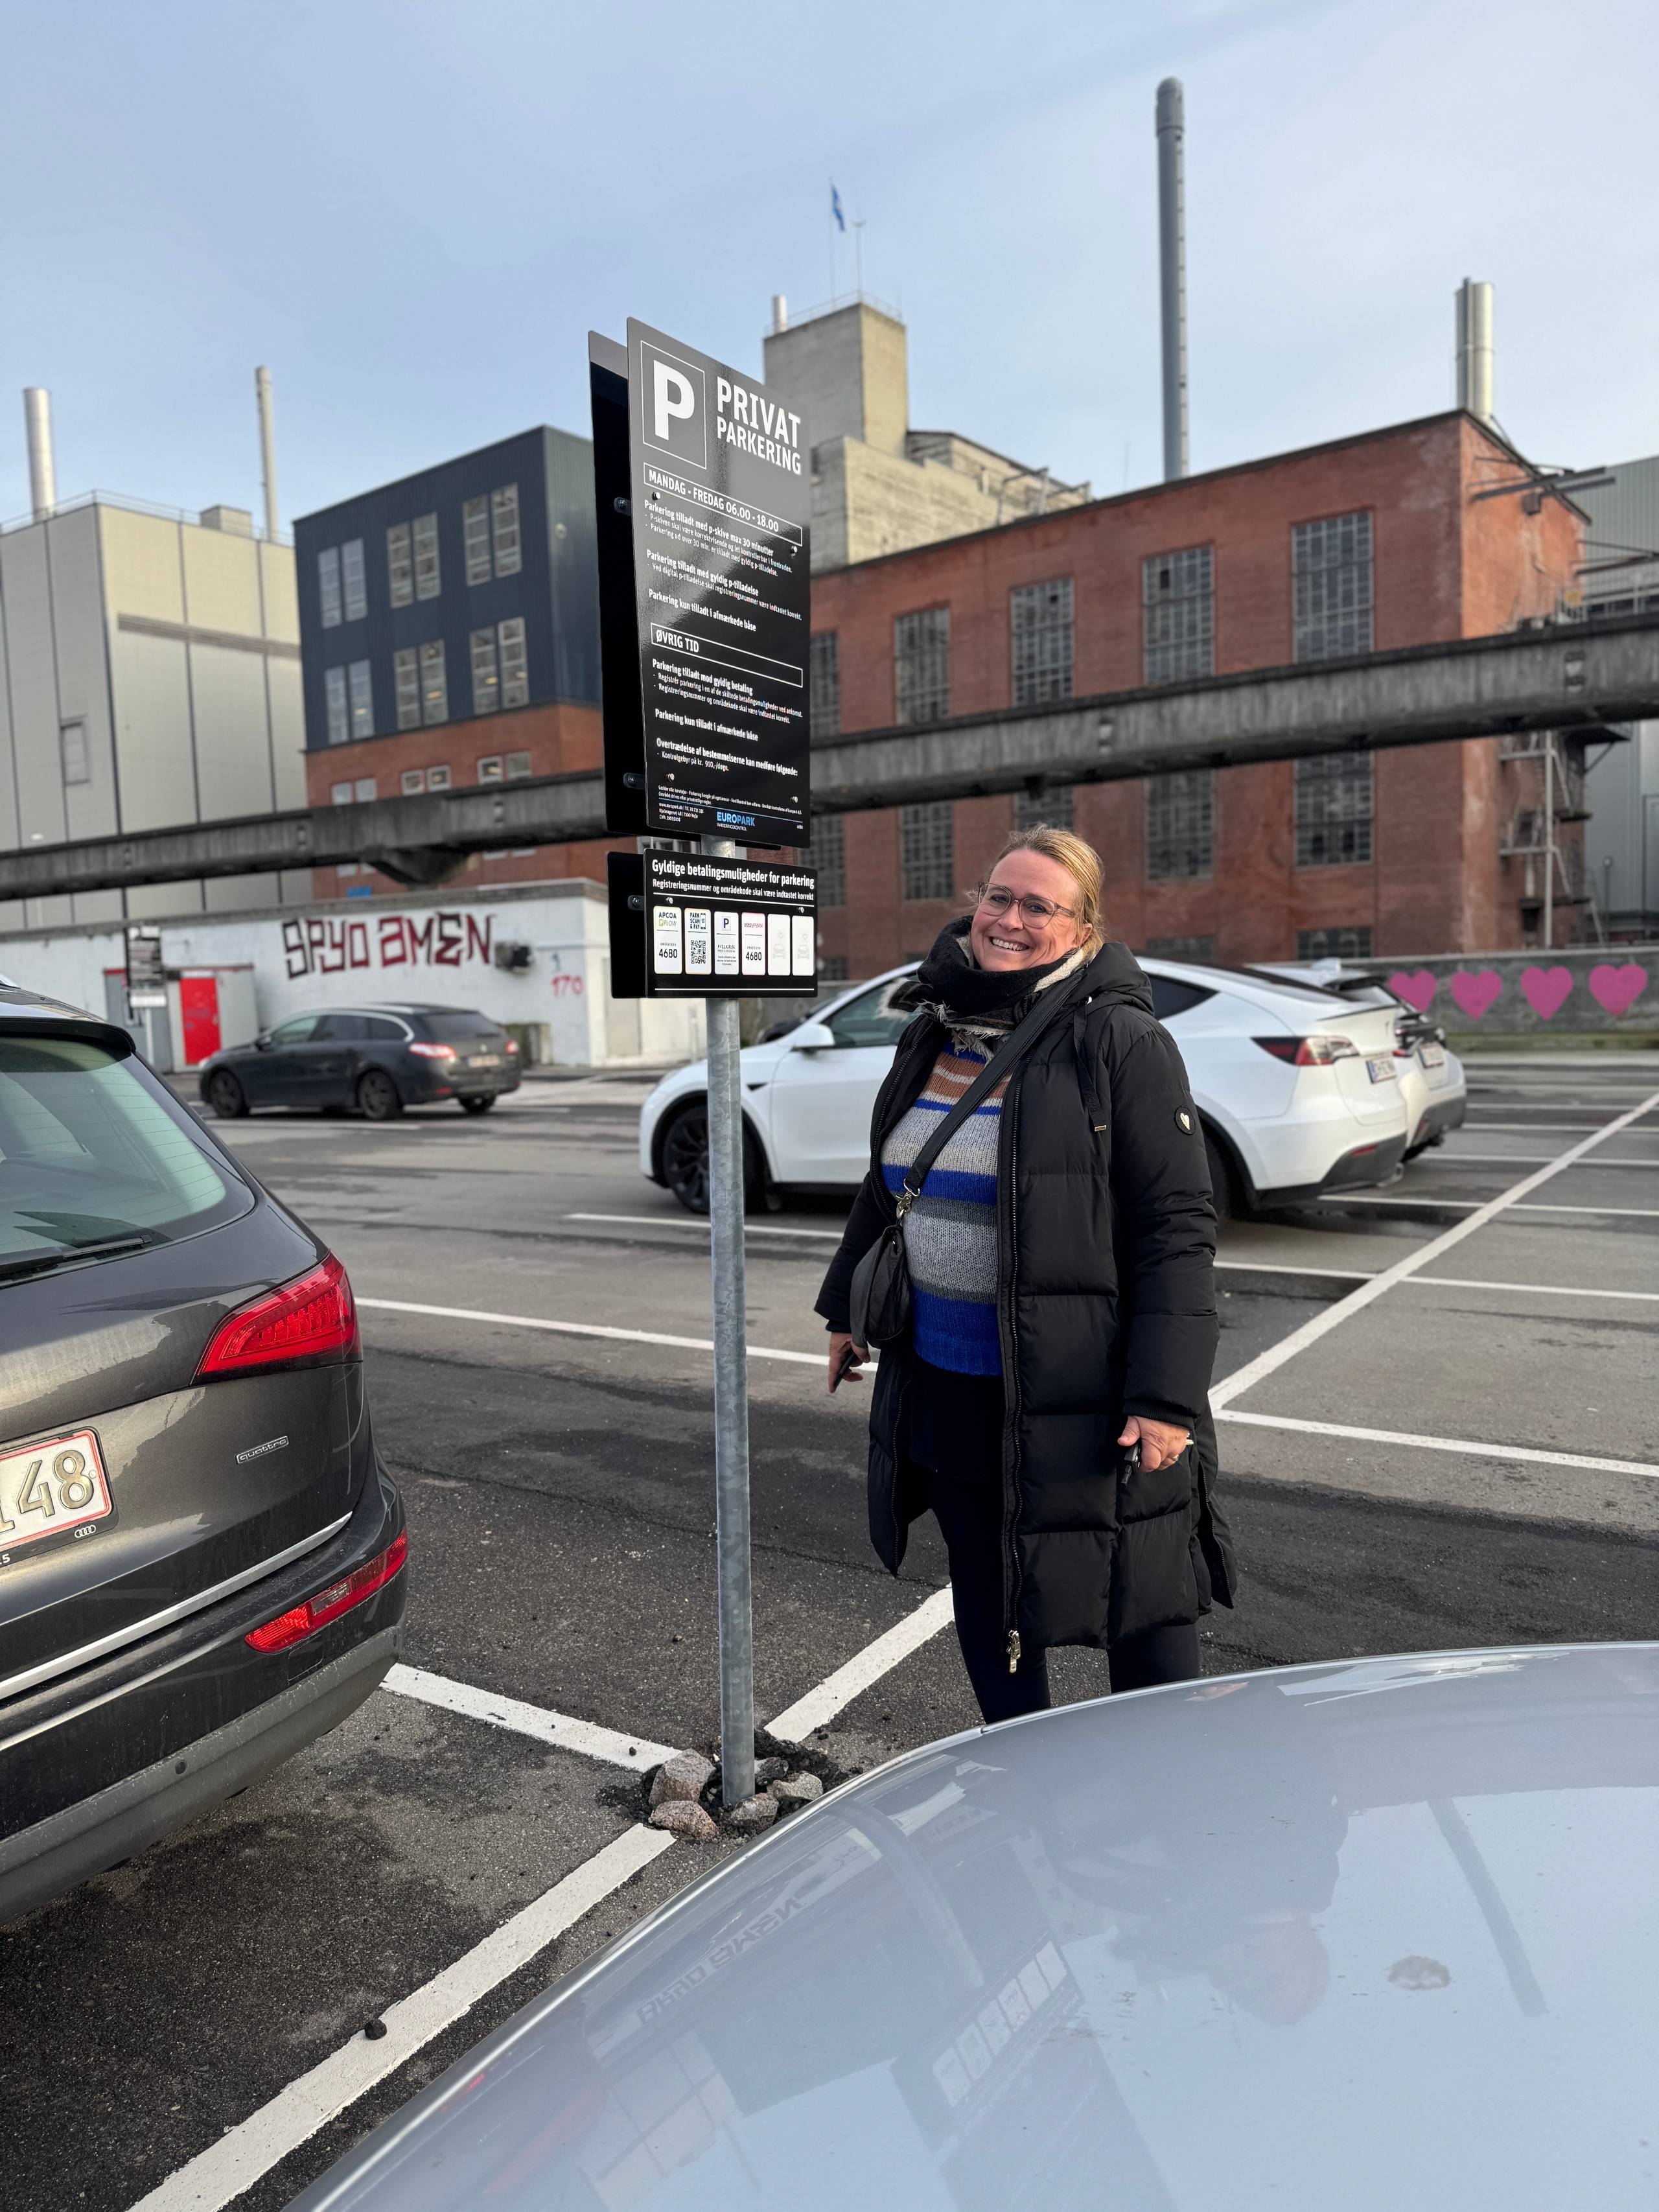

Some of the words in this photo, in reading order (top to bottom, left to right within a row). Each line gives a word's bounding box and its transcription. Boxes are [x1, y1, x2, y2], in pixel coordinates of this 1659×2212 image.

[654, 360, 695, 441] P
[717, 376, 801, 448] PRIVAT
[717, 415, 802, 476] PARKERING
[649, 469, 685, 495] MANDAG
[693, 487, 724, 511] FREDAG
[726, 500, 750, 521] 06.00
[757, 513, 778, 533] 18.00
[644, 498, 674, 521] Parkering
[675, 510, 693, 526] tilladt
[695, 518, 707, 531] med
[708, 523, 728, 541] p-skive
[730, 534, 741, 544] max
[742, 537, 750, 548] 30
[751, 540, 773, 557] minutter
[651, 522, 673, 539] Parkering
[675, 531, 680, 541] ud
[682, 535, 691, 544] over
[693, 538, 699, 548] 30
[717, 547, 730, 559] tilladt
[730, 552, 739, 563] med
[671, 520, 680, 531] skal
[682, 526, 693, 535] være
[647, 548, 676, 570] Parkering
[677, 559, 695, 575] tilladt
[697, 566, 708, 579] med
[710, 570, 727, 587] gyldig
[728, 577, 758, 598] p-tilladelse
[652, 562, 661, 572] Ved
[662, 565, 677, 579] digital
[679, 570, 704, 588] p-tilladelse
[705, 579, 714, 590] skal
[759, 600, 768, 609] være
[649, 588, 678, 608] Parkering
[679, 598, 690, 611] kun
[691, 601, 708, 616] tilladt
[713, 609, 743, 627] afmærkede
[743, 618, 756, 632] båse
[656, 628, 683, 649] ØVRIG
[684, 637, 699, 653] TID
[652, 658, 681, 677] Parkering
[682, 666, 700, 680] tilladt
[701, 671, 712, 683] mod
[713, 675, 730, 690] gyldig
[731, 679, 752, 697] betaling
[680, 678, 701, 692] parkering
[706, 696, 712, 705] og
[655, 708, 684, 726] Parkering
[684, 715, 695, 726] kun
[696, 717, 713, 730] tilladt
[717, 723, 745, 738] afmærkede
[746, 730, 758, 741] båse
[656, 737, 695, 754] Overtrædelse
[695, 745, 701, 756] af
[702, 747, 745, 765] bestemmelserne
[745, 756, 754, 767] kan
[756, 758, 775, 771] medføre
[776, 763, 797, 778] følgende:
[662, 751, 690, 765] Kontrolgebyr
[691, 756, 696, 765] på
[717, 811, 755, 826] EUROPARK
[652, 859, 686, 877] Gyldige
[688, 862, 767, 883] betalingsmuligheder
[769, 871, 780, 884] for
[782, 874, 814, 889] parkering
[653, 878, 712, 892] Registreringsnummer
[713, 885, 719, 894] og
[721, 885, 752, 895] områdekode
[752, 888, 762, 896] skal
[776, 889, 797, 900] indtastet
[797, 892, 814, 901] korrekt
[723, 918, 730, 929] P
[658, 949, 678, 958] 4680
[745, 951, 762, 960] 4680
[240, 1439, 286, 1460] quattro
